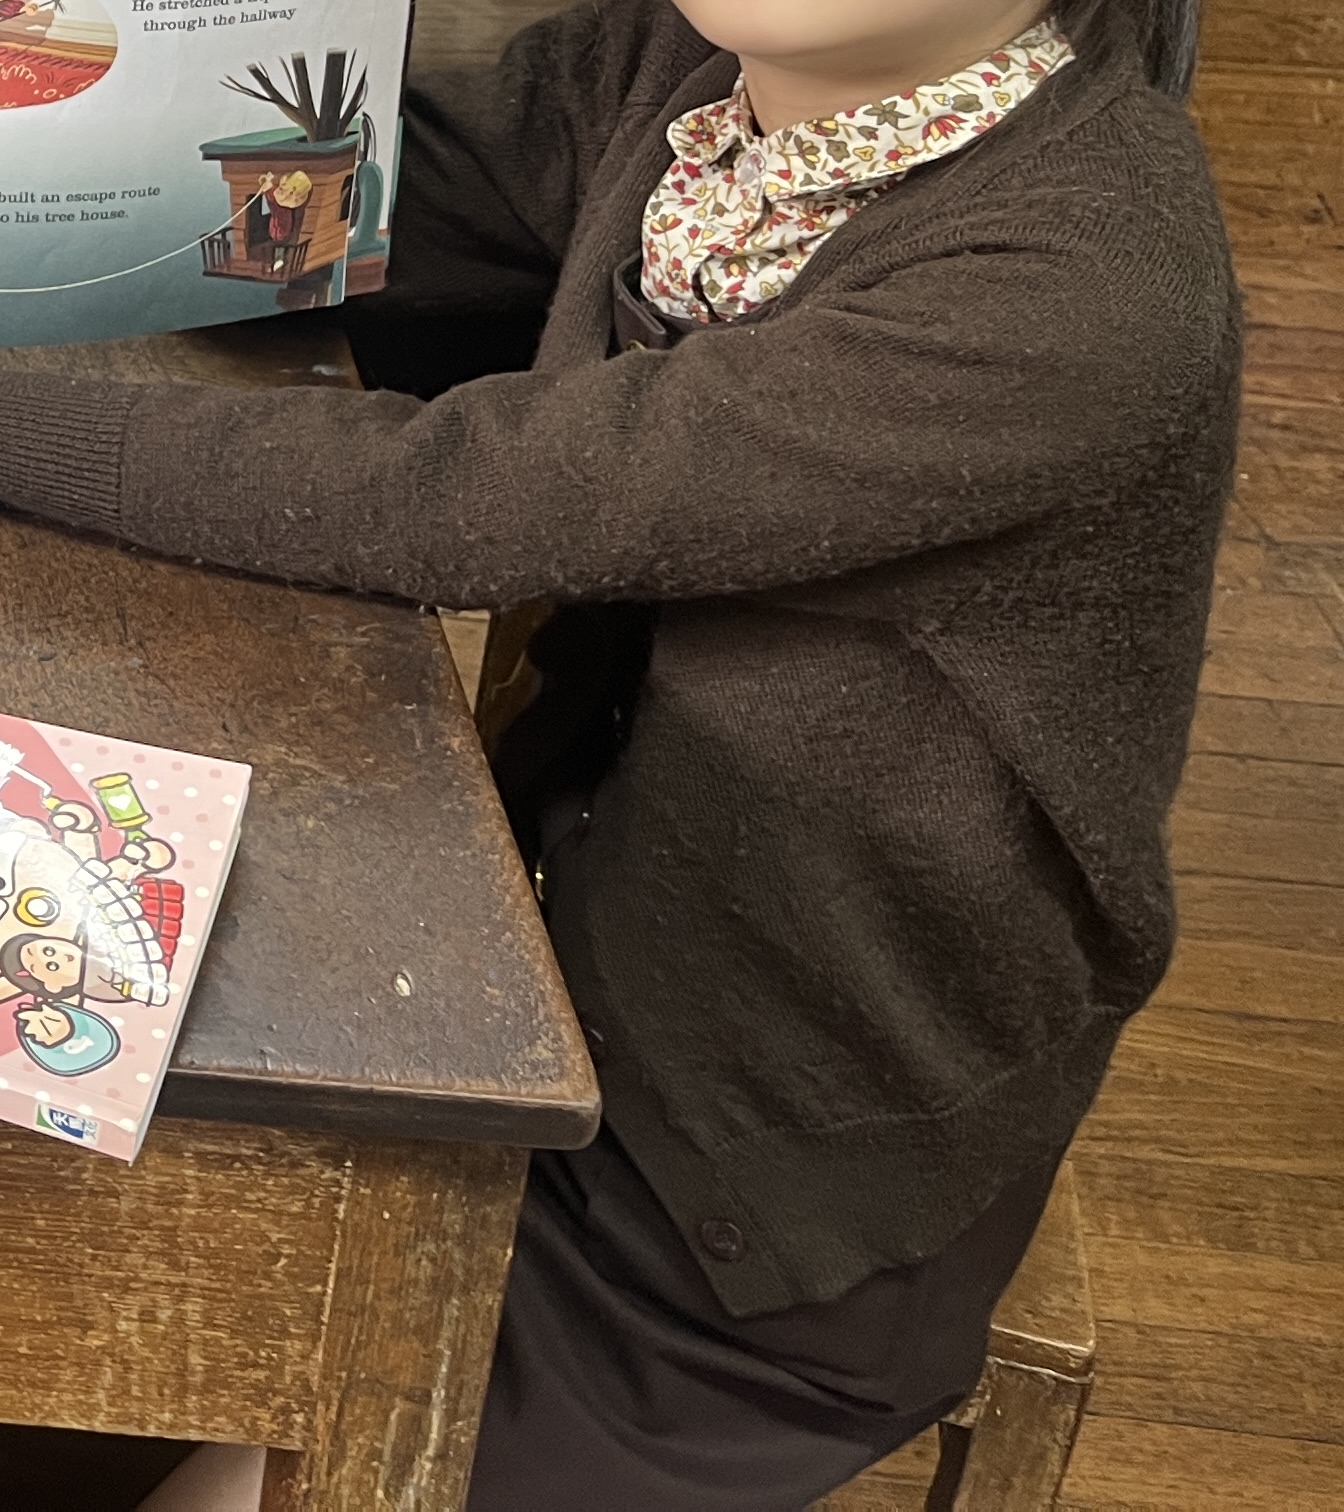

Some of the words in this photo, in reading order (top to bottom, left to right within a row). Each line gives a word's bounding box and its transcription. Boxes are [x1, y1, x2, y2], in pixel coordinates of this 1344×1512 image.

[132, 0, 154, 11] He
[144, 17, 207, 31] through
[213, 15, 235, 26] the
[240, 8, 296, 23] hallway
[41, 193, 60, 203] an
[66, 191, 116, 204] escape
[121, 186, 160, 199] route
[15, 212, 39, 223] his
[46, 212, 75, 222] tree
[80, 208, 129, 221] house.
